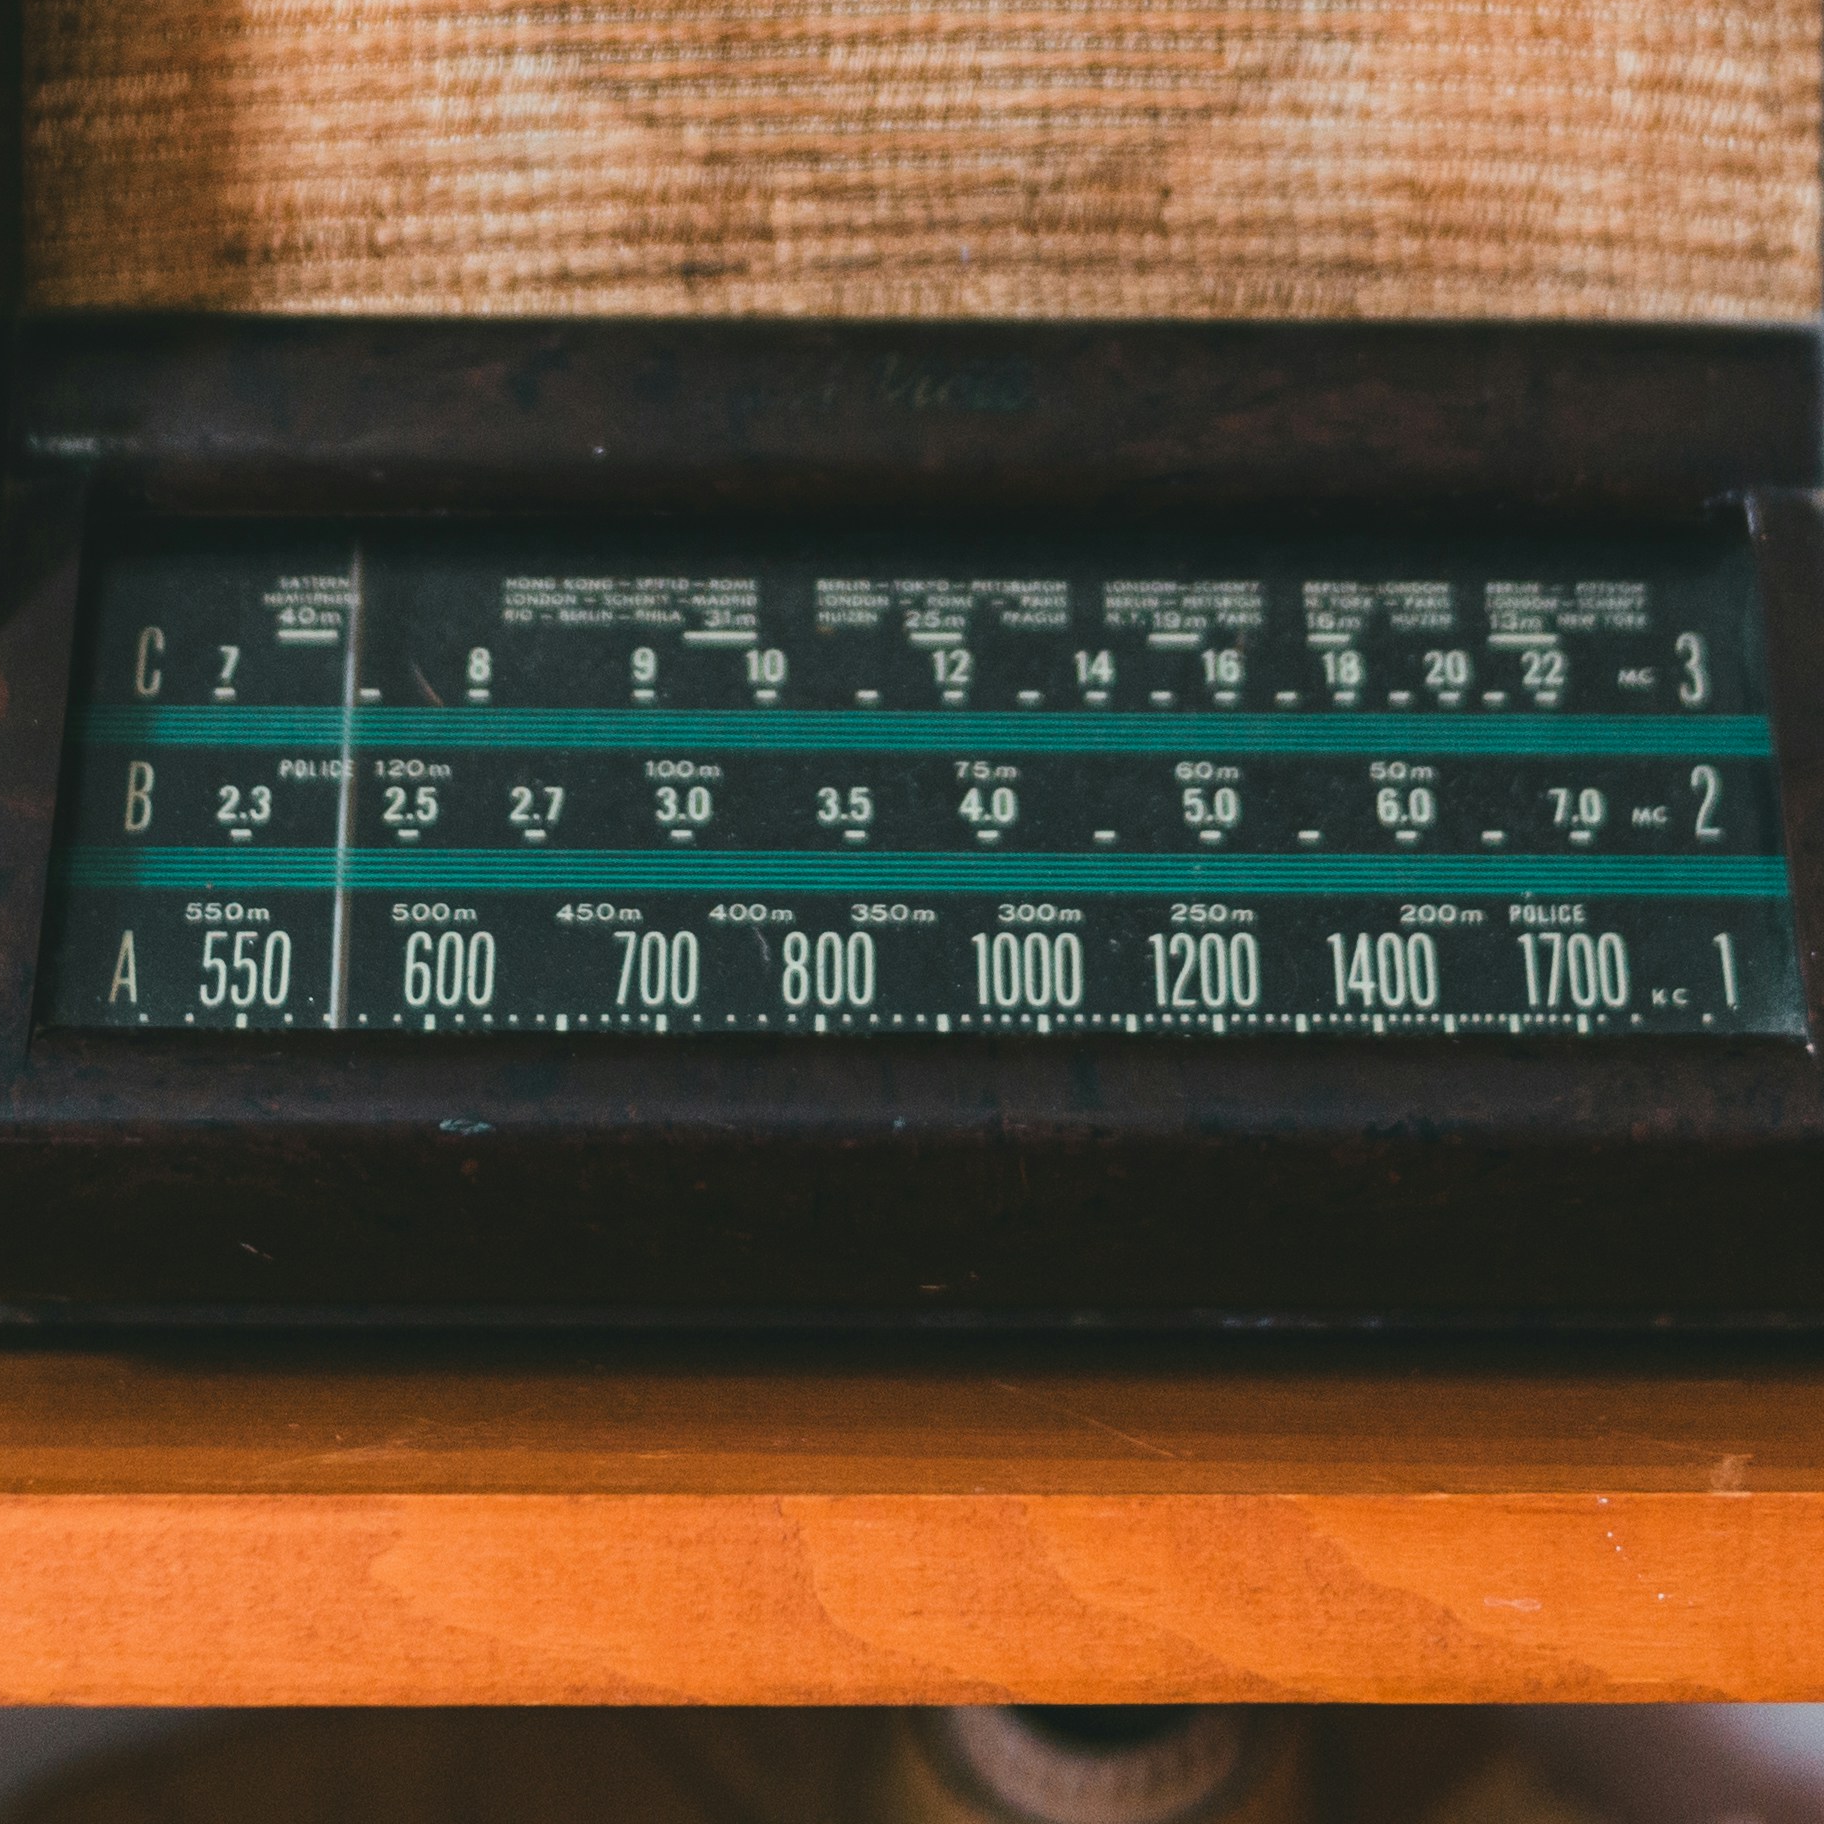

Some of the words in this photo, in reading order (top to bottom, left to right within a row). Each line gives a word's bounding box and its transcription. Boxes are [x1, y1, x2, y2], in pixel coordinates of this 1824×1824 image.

[505, 578, 556, 591] HONG
[562, 578, 613, 591] KONG
[709, 579, 756, 591] ROME
[816, 579, 871, 593] BERLIN
[505, 593, 576, 606] LONDON
[819, 594, 890, 608] LONDON
[1021, 595, 1066, 608] PARIS
[279, 607, 342, 625] 40m
[504, 609, 533, 622] RIO
[559, 609, 613, 622] BERLIN
[905, 610, 966, 628] 25m
[135, 626, 166, 697] C
[220, 645, 240, 682] 7
[467, 647, 492, 684] 8
[632, 646, 657, 683] 9
[746, 648, 787, 685] 10
[933, 648, 971, 683] 12
[1074, 650, 1115, 685] 14
[1202, 649, 1242, 685] 16
[1322, 650, 1364, 688] 18
[1424, 650, 1470, 687] 20
[1522, 651, 1565, 686] 22
[1675, 632, 1708, 705] 3
[279, 759, 353, 778] POLICE
[375, 758, 452, 779] 120m
[645, 759, 721, 780] 100m
[955, 760, 1018, 782] 75m
[1174, 760, 1240, 782] 60m
[1369, 761, 1434, 782] 50m
[125, 761, 155, 831] B
[216, 784, 272, 823] 2.3
[383, 786, 439, 823] 2.5
[509, 786, 564, 824] 2.7
[655, 786, 712, 823] 3.0
[817, 786, 873, 824] 3.5
[959, 787, 1017, 824] 4.0
[1182, 787, 1240, 828] 5.0
[1376, 787, 1434, 825] 6.0
[1548, 787, 1605, 826] 7.0
[1631, 806, 1668, 825] MC
[1690, 764, 1721, 838] 2
[185, 901, 270, 922] 550m
[392, 902, 477, 923] 500m
[555, 902, 643, 923] 450m
[708, 903, 794, 923] 400m
[851, 903, 936, 924] 350m
[998, 903, 1083, 924] 300m
[1170, 902, 1255, 924] 250m
[1400, 903, 1484, 924] 200m
[1508, 904, 1585, 925] POLICE
[109, 930, 138, 1004] A
[199, 930, 292, 1008] 550
[404, 930, 496, 1007] 600
[614, 930, 699, 1007] 700
[782, 931, 875, 1007] 800
[971, 931, 1083, 1008] 1000
[1148, 932, 1260, 1009] 1200
[1327, 932, 1438, 1009] 1400
[1517, 931, 1629, 1009] 1700
[1713, 932, 1738, 1010] 1
